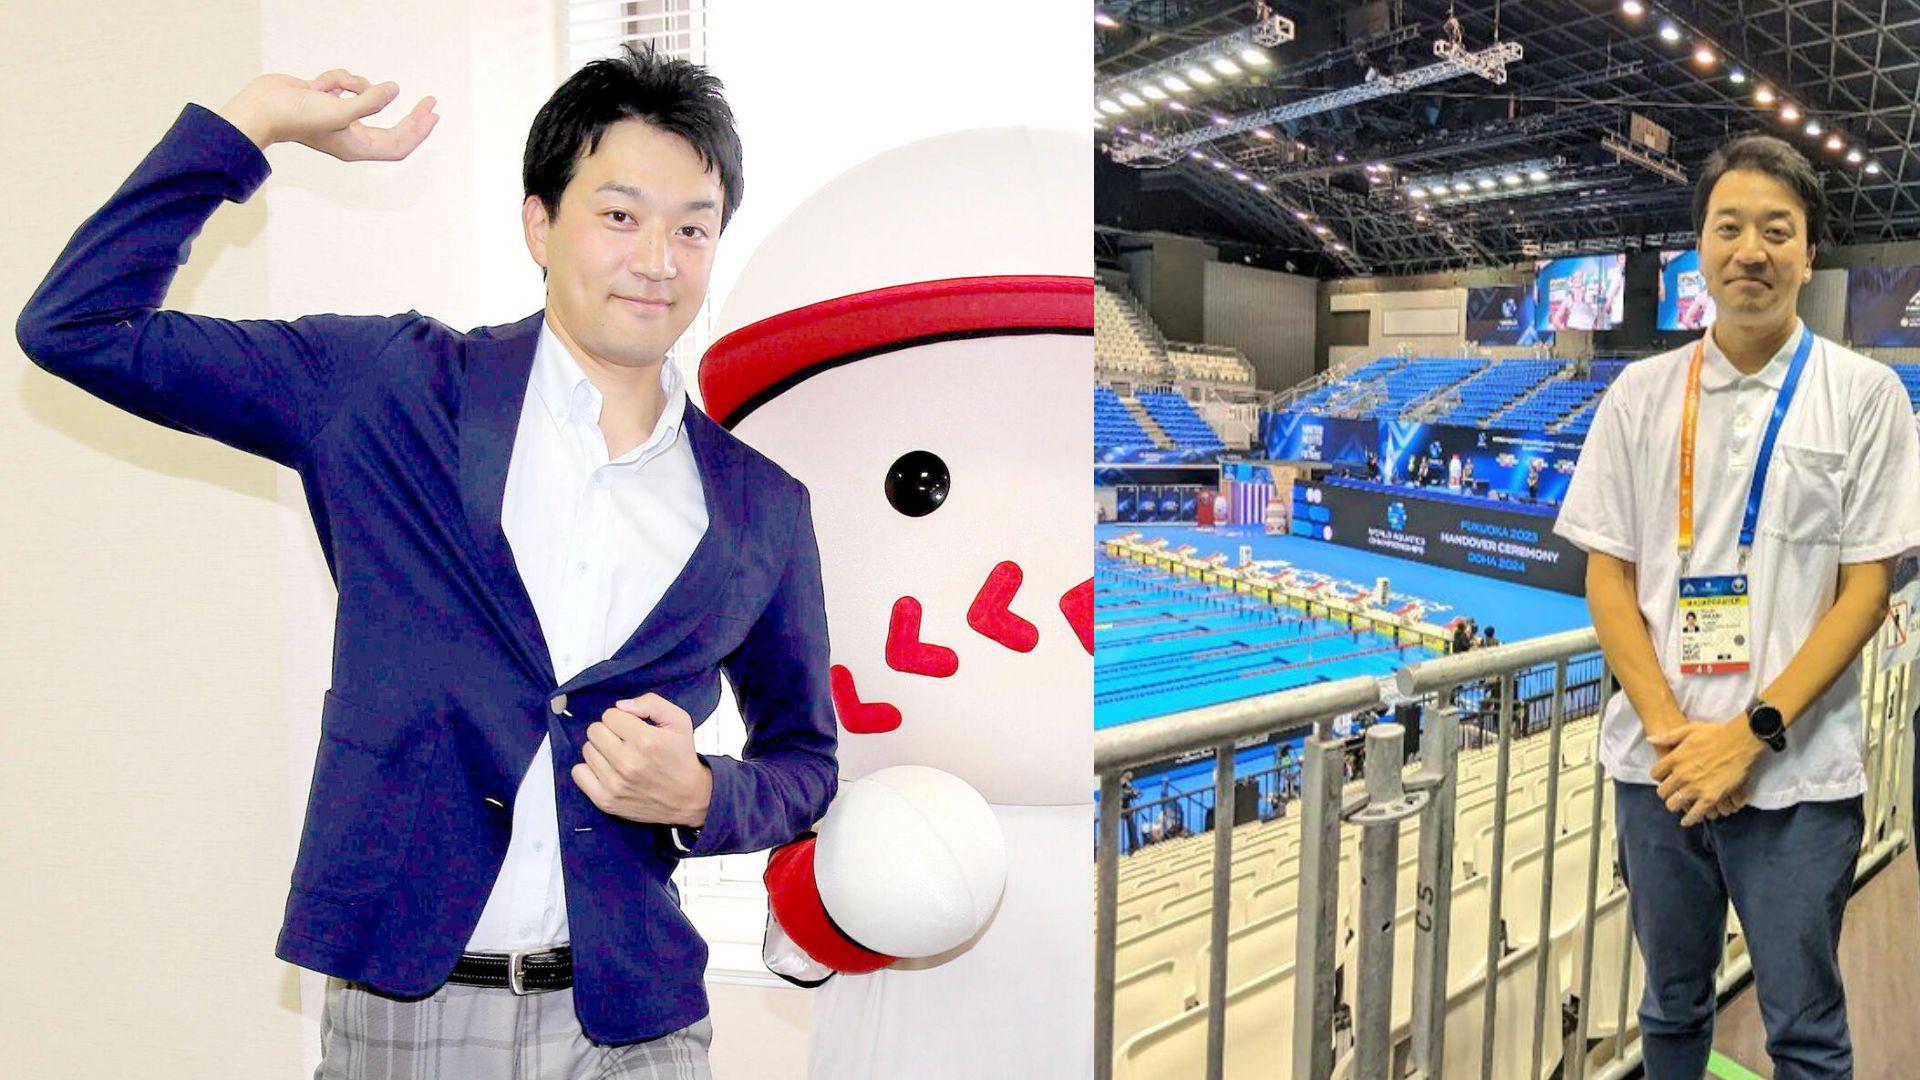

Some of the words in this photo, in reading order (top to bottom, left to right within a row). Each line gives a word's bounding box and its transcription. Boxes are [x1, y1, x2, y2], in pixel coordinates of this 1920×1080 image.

[1460, 519, 1509, 538] FUKUOKA
[1510, 527, 1539, 543] 2023
[1440, 532, 1497, 552] HANDOVER
[1498, 541, 1560, 564] CEREMONY
[1467, 552, 1497, 567] DOHA
[1498, 557, 1526, 573] 2024
